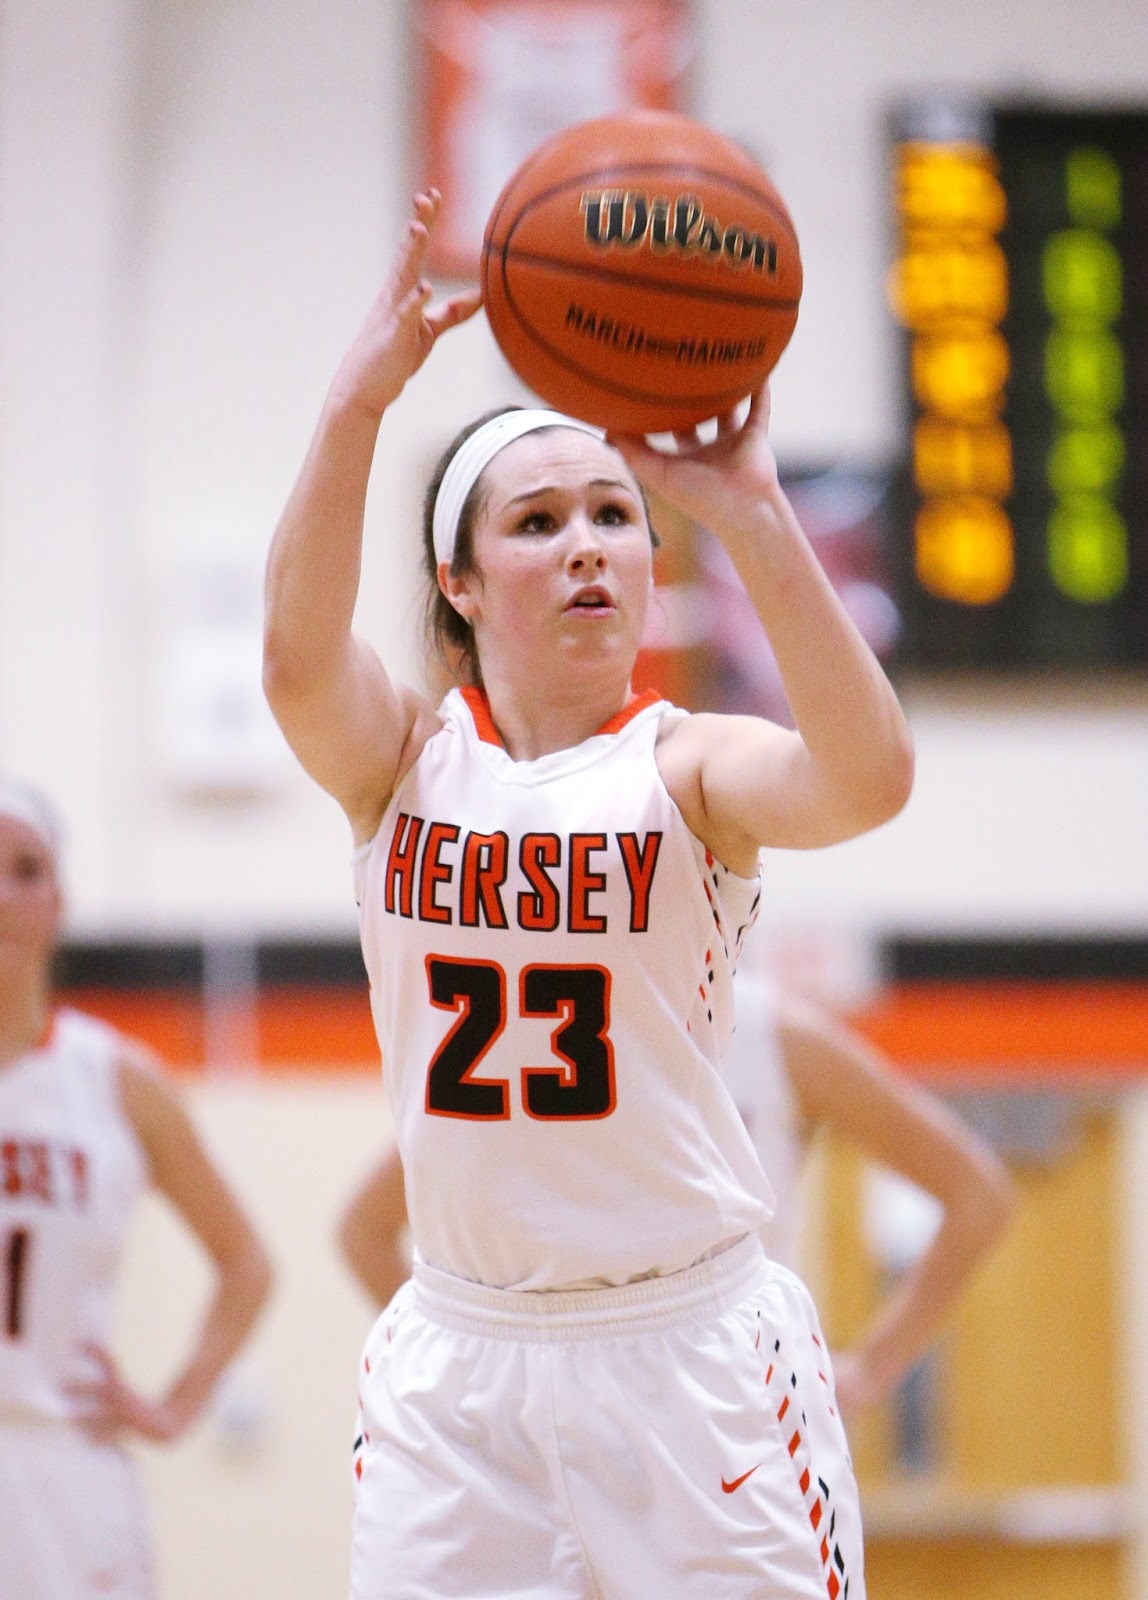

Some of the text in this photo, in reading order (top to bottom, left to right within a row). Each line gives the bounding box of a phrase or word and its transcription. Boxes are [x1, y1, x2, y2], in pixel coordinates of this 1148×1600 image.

[579, 189, 777, 276] Wilson
[565, 302, 645, 355] MARCH
[676, 335, 766, 366] MADNESS
[385, 812, 663, 934] HERSEY
[425, 952, 618, 1122] 23
